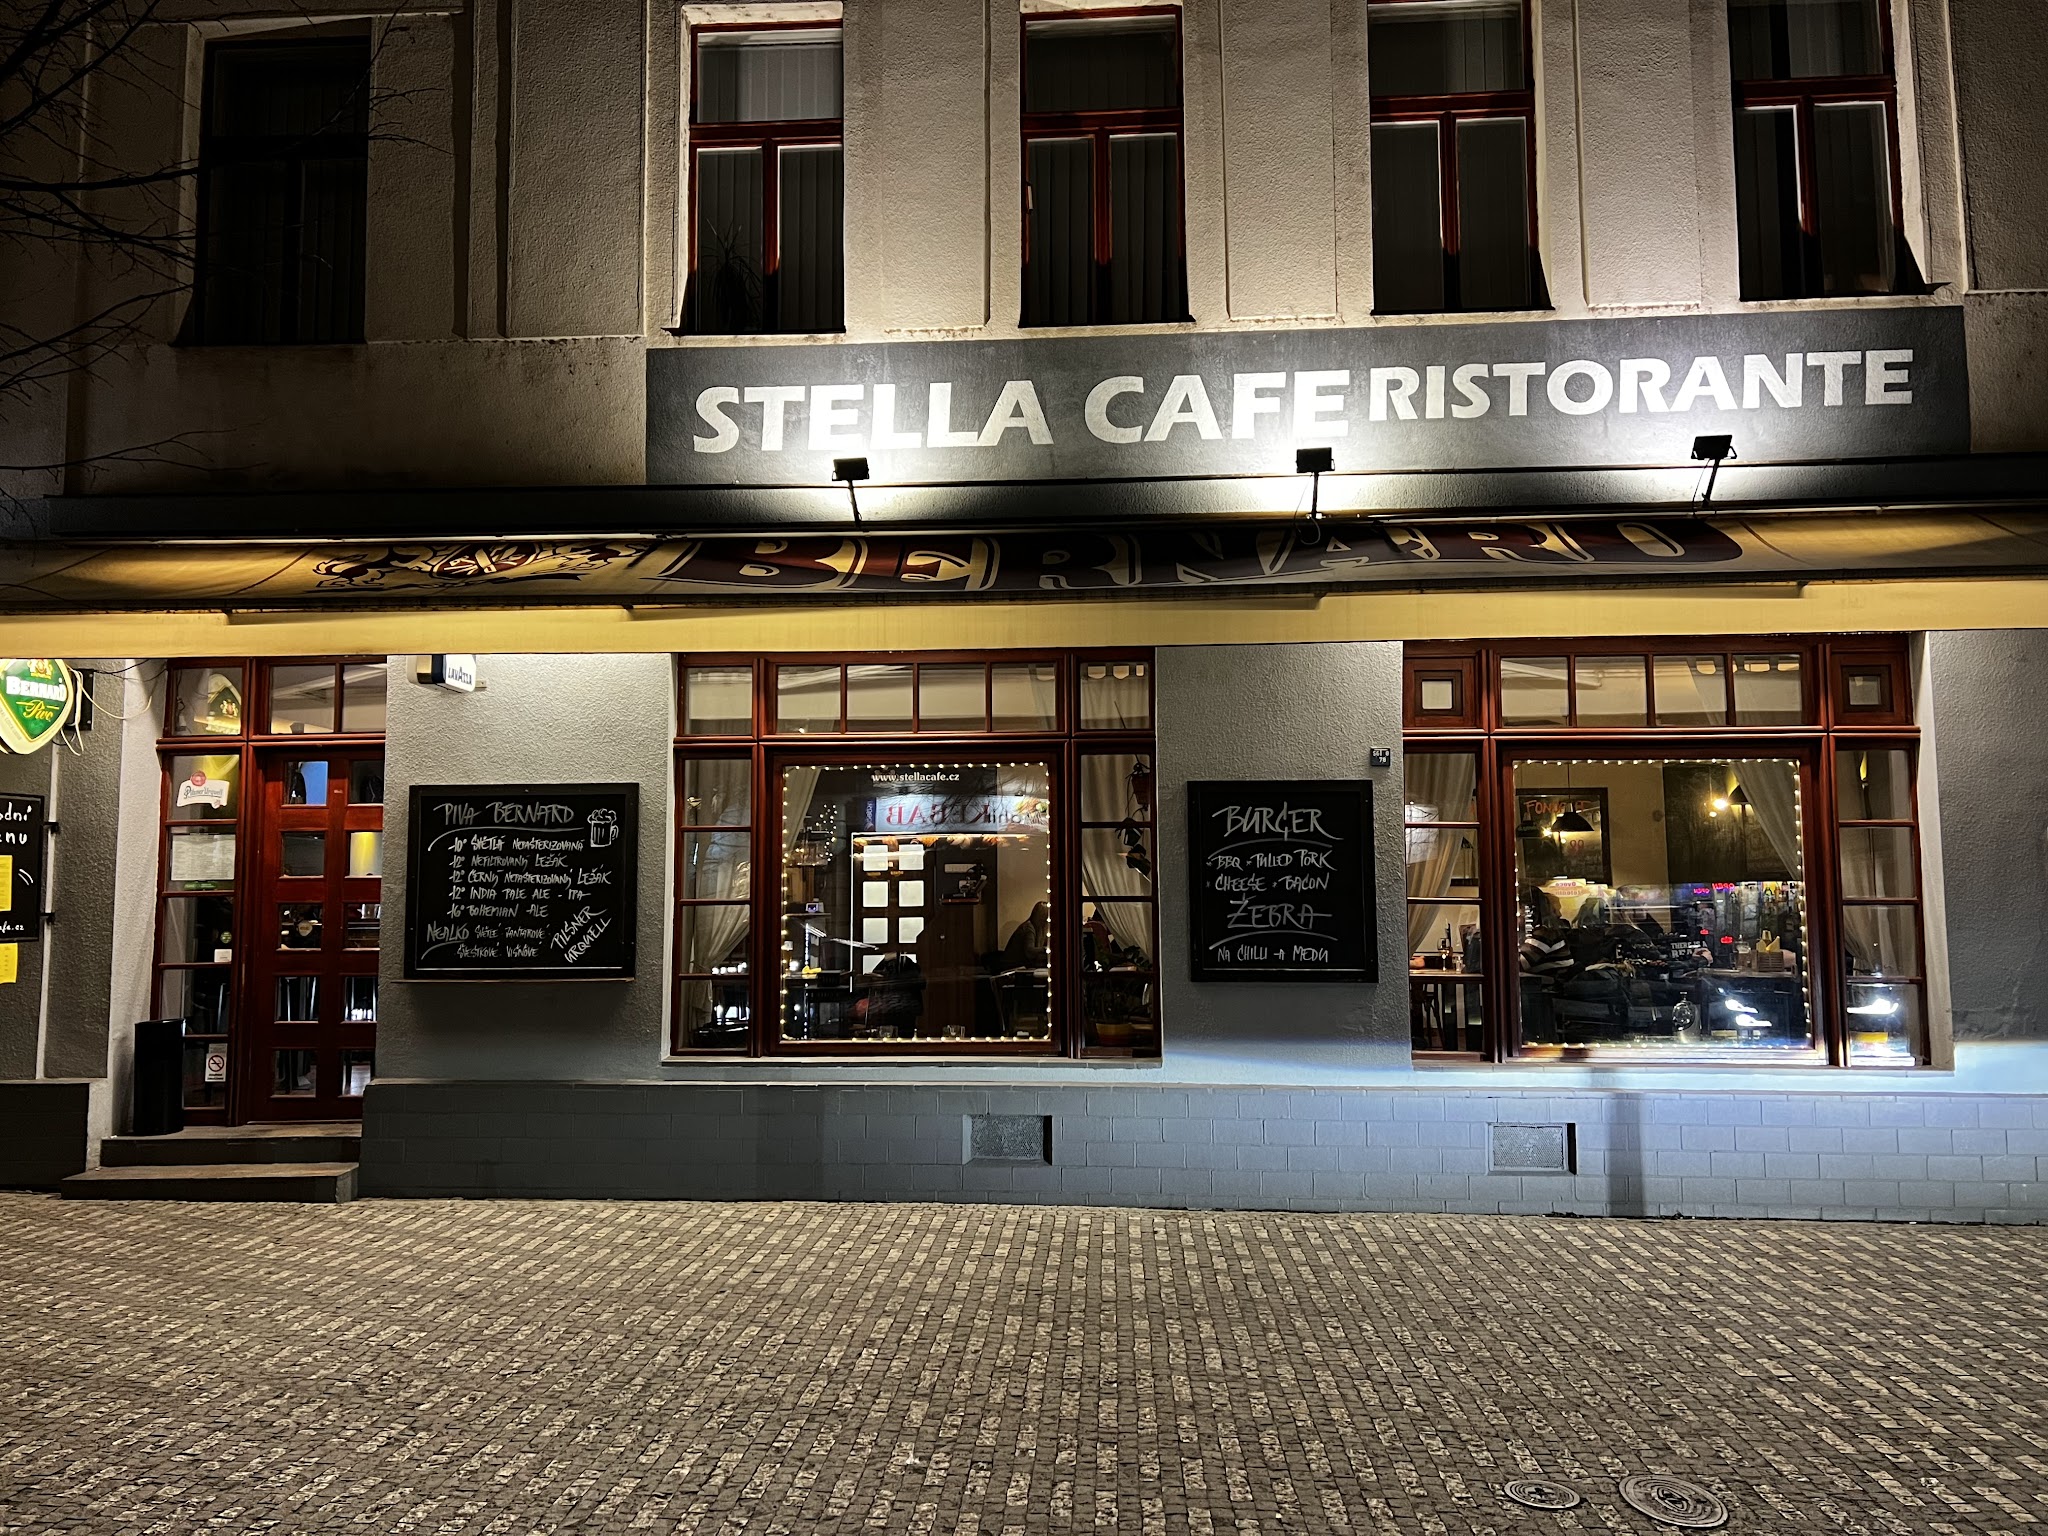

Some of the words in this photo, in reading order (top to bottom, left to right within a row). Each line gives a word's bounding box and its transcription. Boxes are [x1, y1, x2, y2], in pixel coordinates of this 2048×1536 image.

[693, 380, 1054, 453] STELLA
[1084, 369, 1349, 444] CAFE
[1369, 348, 1914, 421] RISTORANTE
[871, 771, 960, 781] www.stellacafe.cz
[433, 803, 482, 825] PIVA
[486, 801, 574, 825] BERNARD
[1212, 801, 1344, 841] BURGER
[1211, 855, 1244, 872] BBQ
[1250, 853, 1293, 868] PULLED
[1293, 849, 1338, 871] PORK
[1215, 873, 1267, 892] CHEESE
[1278, 872, 1330, 892] BACON
[470, 887, 497, 900] INDIA
[502, 889, 527, 900] PALE
[532, 889, 551, 900] ALE
[467, 903, 519, 917] BOHEMIAN
[526, 904, 549, 917] ALE
[427, 921, 469, 942] NEALKO
[550, 906, 607, 949] PILSNER
[564, 918, 612, 963] URQUELL
[1217, 946, 1230, 962] NA
[1293, 945, 1328, 963] MEDU
